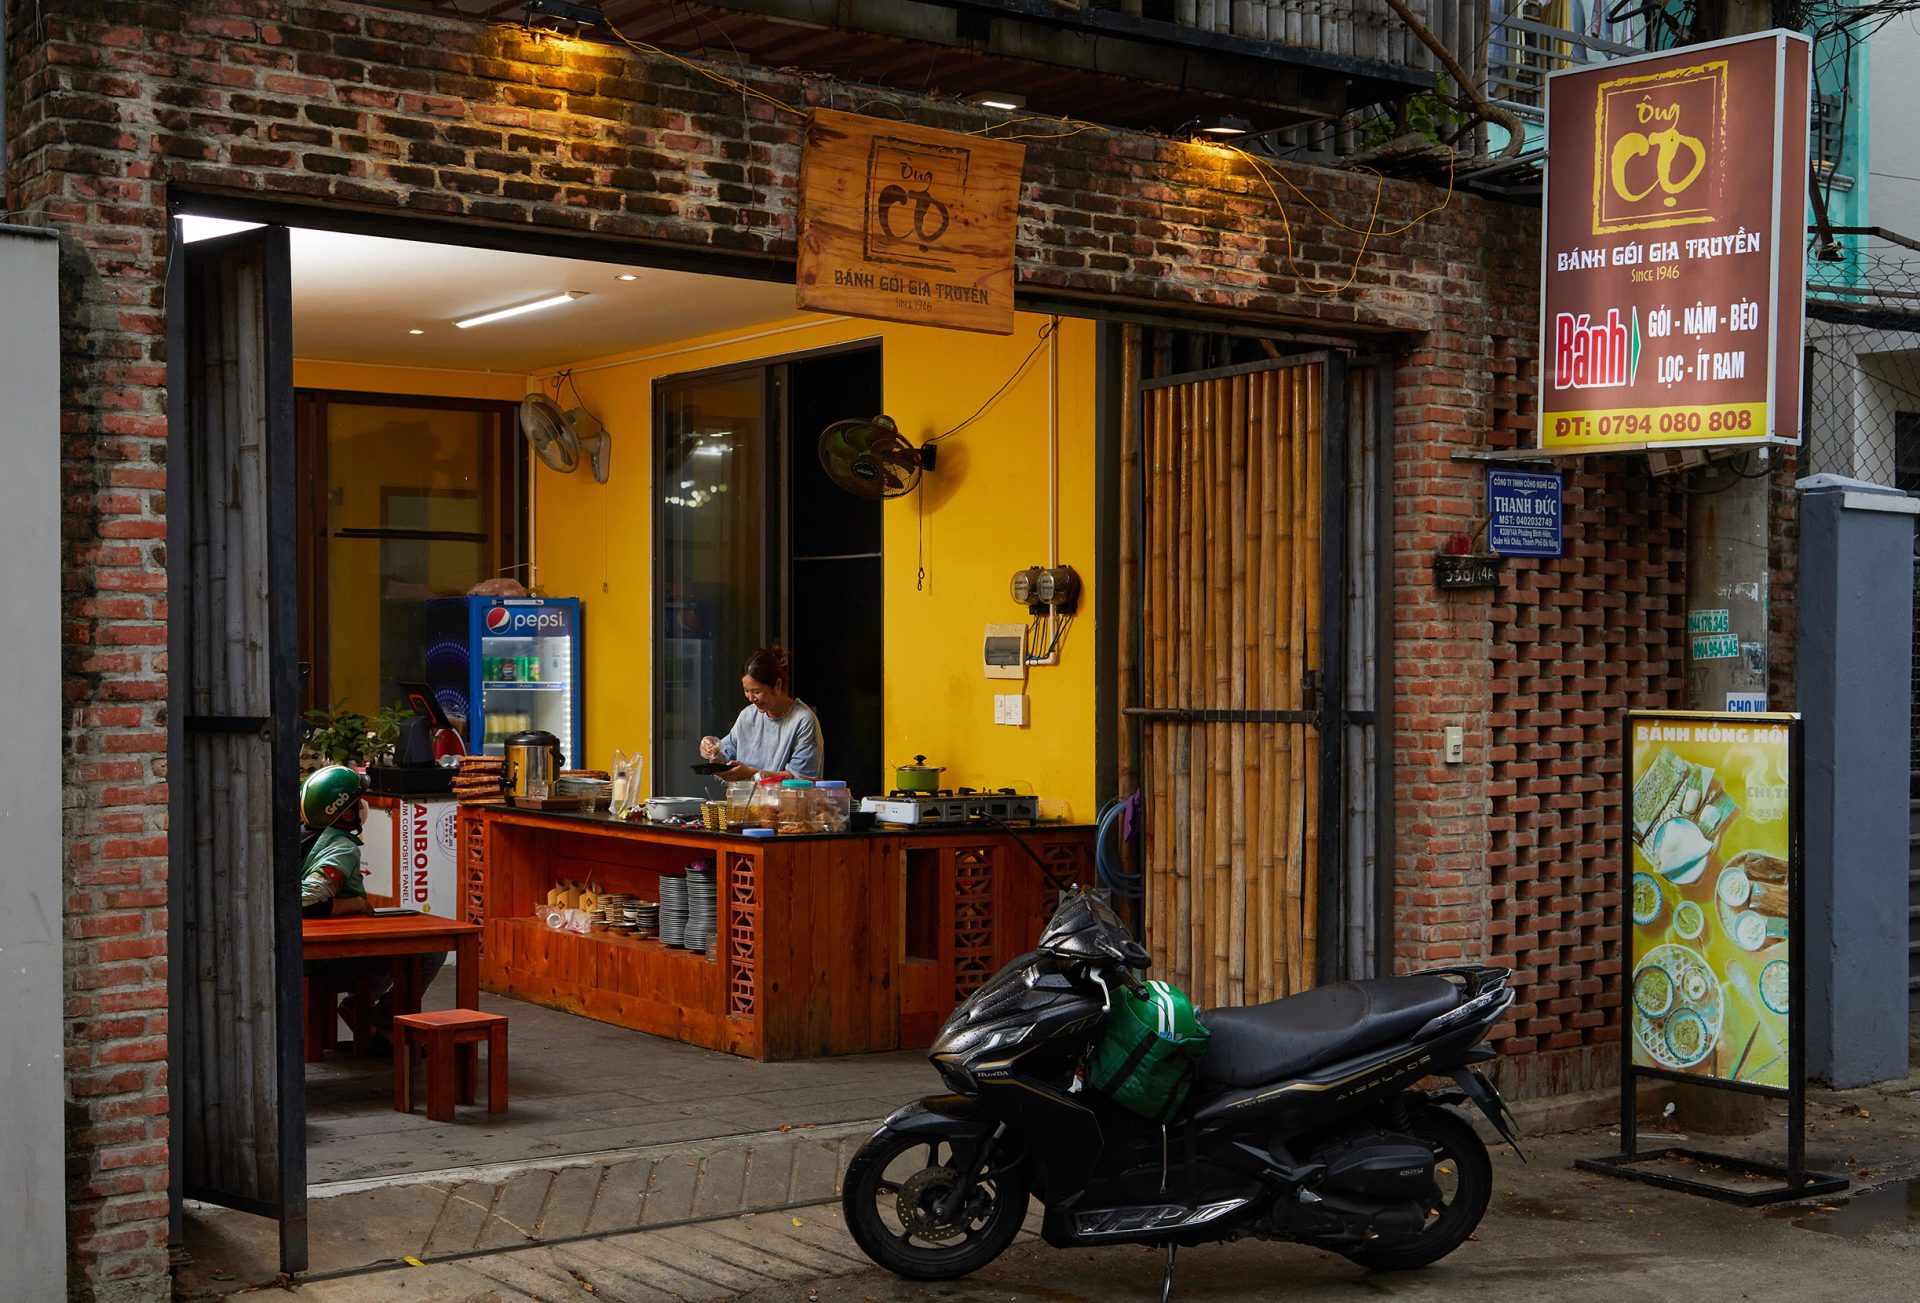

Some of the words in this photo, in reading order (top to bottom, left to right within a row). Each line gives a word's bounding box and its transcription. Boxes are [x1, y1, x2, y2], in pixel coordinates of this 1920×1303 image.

[1635, 95, 1680, 129] Ông
[900, 158, 933, 191] Ông
[1557, 247, 1606, 272] BÁNH
[1612, 241, 1643, 266] GÓI
[1649, 241, 1679, 262] GIA
[1686, 226, 1761, 259] TRUYỀN
[1656, 265, 1680, 281] 1946
[834, 268, 874, 289] BÁNH
[880, 274, 903, 293] GÓI
[908, 280, 931, 297] GIA
[935, 282, 989, 305] TRUYỀN
[914, 301, 933, 312] 1946
[1648, 304, 1671, 337] GÓI
[1684, 301, 1717, 340] NẬM
[1730, 297, 1758, 331] BÈO
[1555, 308, 1628, 390] Bánh
[1658, 355, 1684, 388] LỌC
[1697, 348, 1710, 381] ÍT
[1713, 351, 1745, 380] RAM
[1555, 417, 1590, 436] ĐT:
[1598, 415, 1651, 435] 0794
[1659, 412, 1700, 432] 080
[1708, 410, 1751, 431] 808
[1494, 496, 1532, 514] THANH
[1535, 495, 1557, 515] ĐỨC
[1499, 515, 1515, 525] MST:
[514, 611, 563, 631] pepsi
[1637, 720, 1690, 742] BÁNH
[1695, 722, 1749, 744] NÓNG
[325, 792, 350, 815] Grab
[413, 800, 429, 903] ANBOND
[977, 1070, 1009, 1078] HONDA
